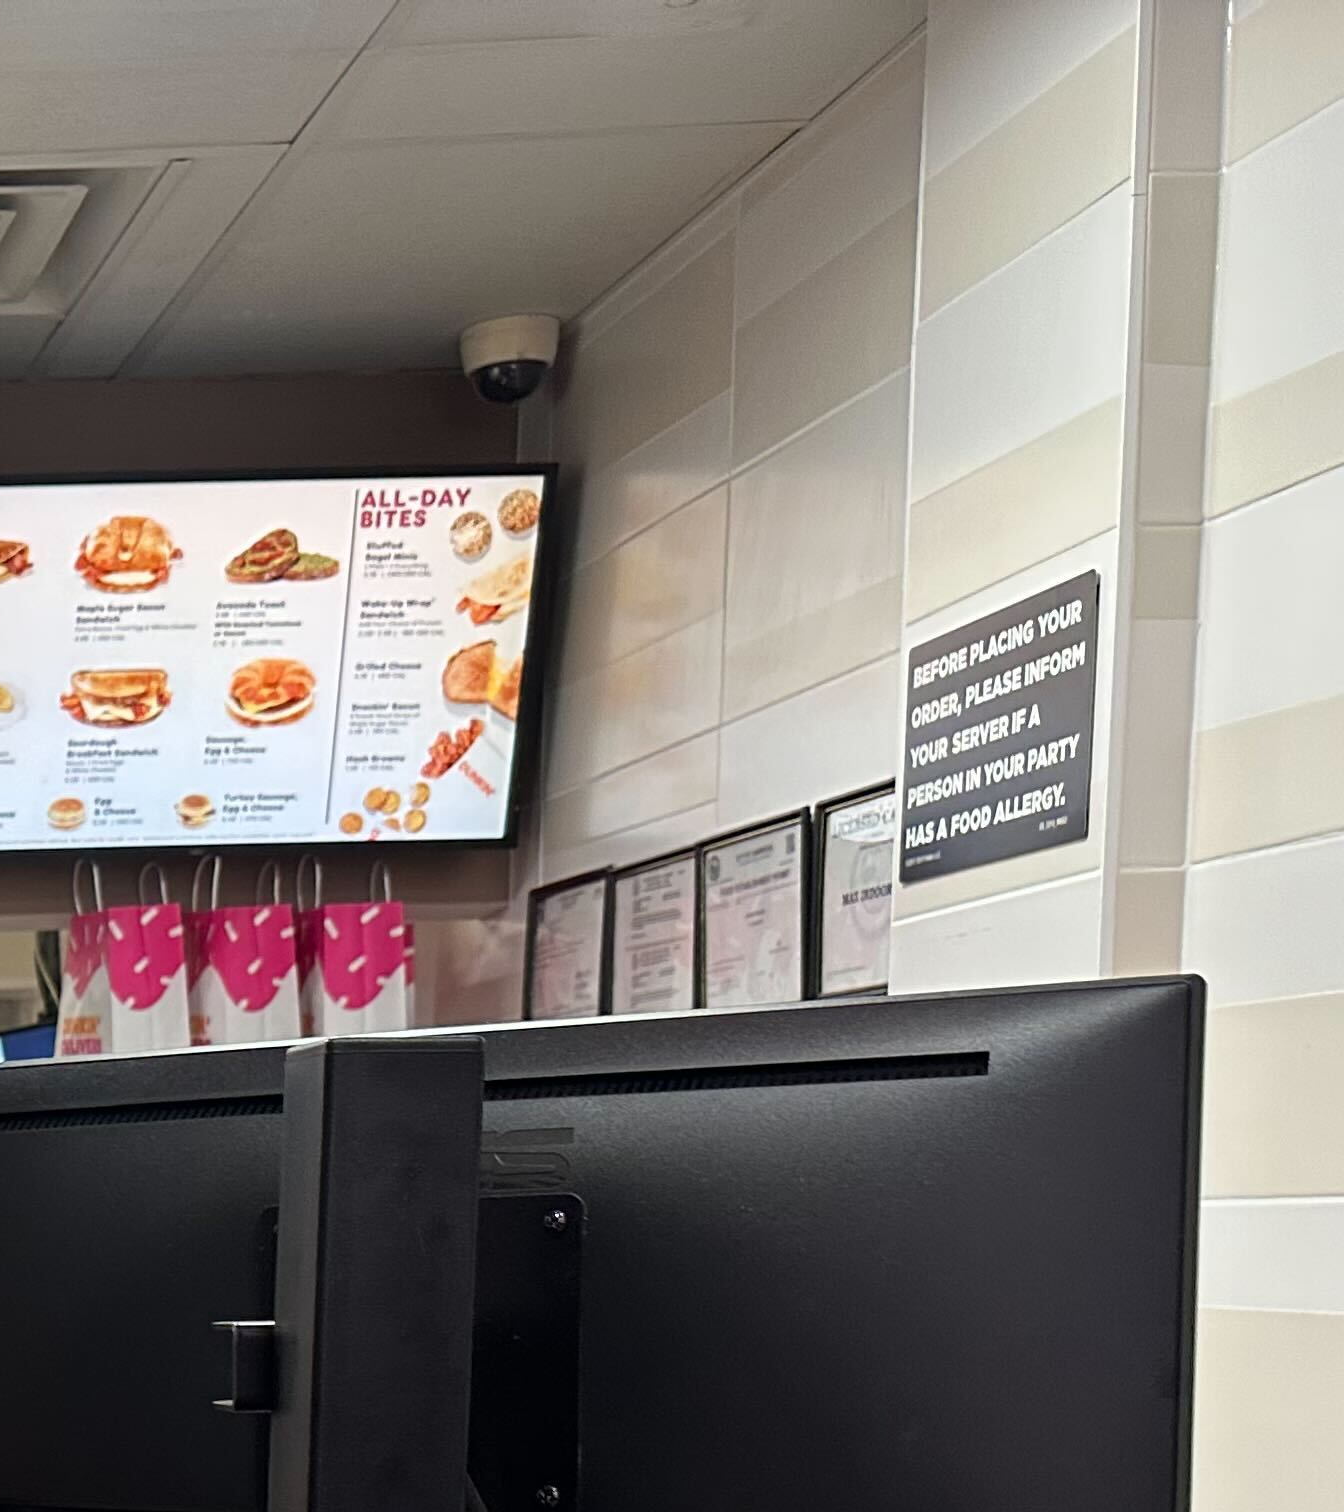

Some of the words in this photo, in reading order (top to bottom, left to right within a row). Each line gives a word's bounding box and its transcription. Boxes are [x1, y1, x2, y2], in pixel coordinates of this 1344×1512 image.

[360, 510, 427, 529] BITES
[362, 488, 472, 508] ALL-DAY
[912, 648, 967, 689] BEFORE
[970, 619, 1034, 666] PLACING
[1038, 600, 1082, 637] YOUR
[911, 694, 962, 730] ORDER,
[965, 669, 1022, 710] PLEASE
[1024, 642, 1086, 687] INFORM
[910, 740, 948, 769] YOUR
[952, 715, 1009, 754] SERVER
[1012, 708, 1026, 734] IF
[1028, 704, 1041, 730] A
[907, 772, 963, 810] PERSON
[965, 764, 980, 790] IN
[984, 748, 1024, 784] YOUR
[1027, 734, 1080, 772] PARTY
[905, 819, 935, 850] HAS
[936, 814, 948, 842] A
[950, 803, 992, 837] FOOD
[994, 782, 1066, 826] ALLERGY.
